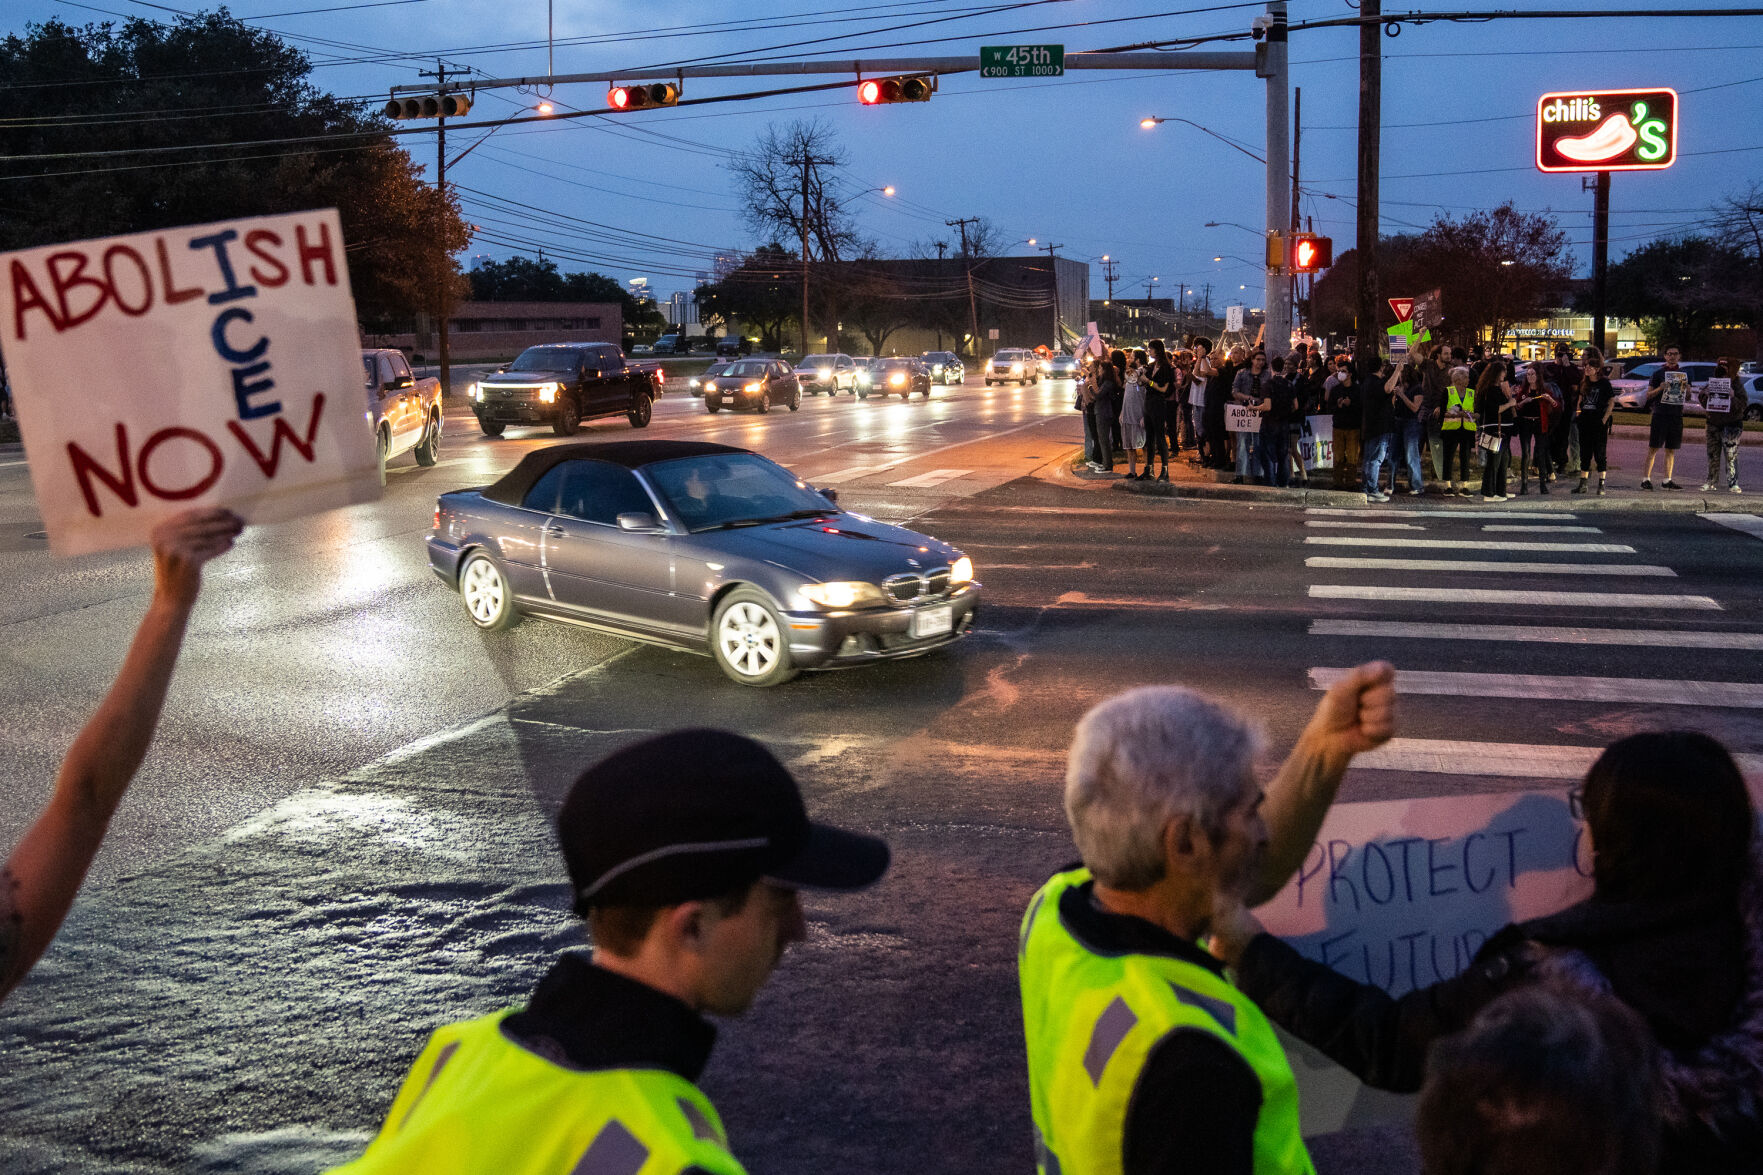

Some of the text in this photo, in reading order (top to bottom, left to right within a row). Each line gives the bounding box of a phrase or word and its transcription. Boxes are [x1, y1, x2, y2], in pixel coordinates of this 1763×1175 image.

[993, 46, 1051, 65] W 45th
[990, 65, 1054, 76] 900 ST 1000
[1543, 97, 1601, 122] chili's
[8, 220, 339, 342] ABOLISH
[1236, 419, 1252, 428] ICE
[66, 392, 326, 518] NOW
[1297, 828, 1528, 910] PROTECT
